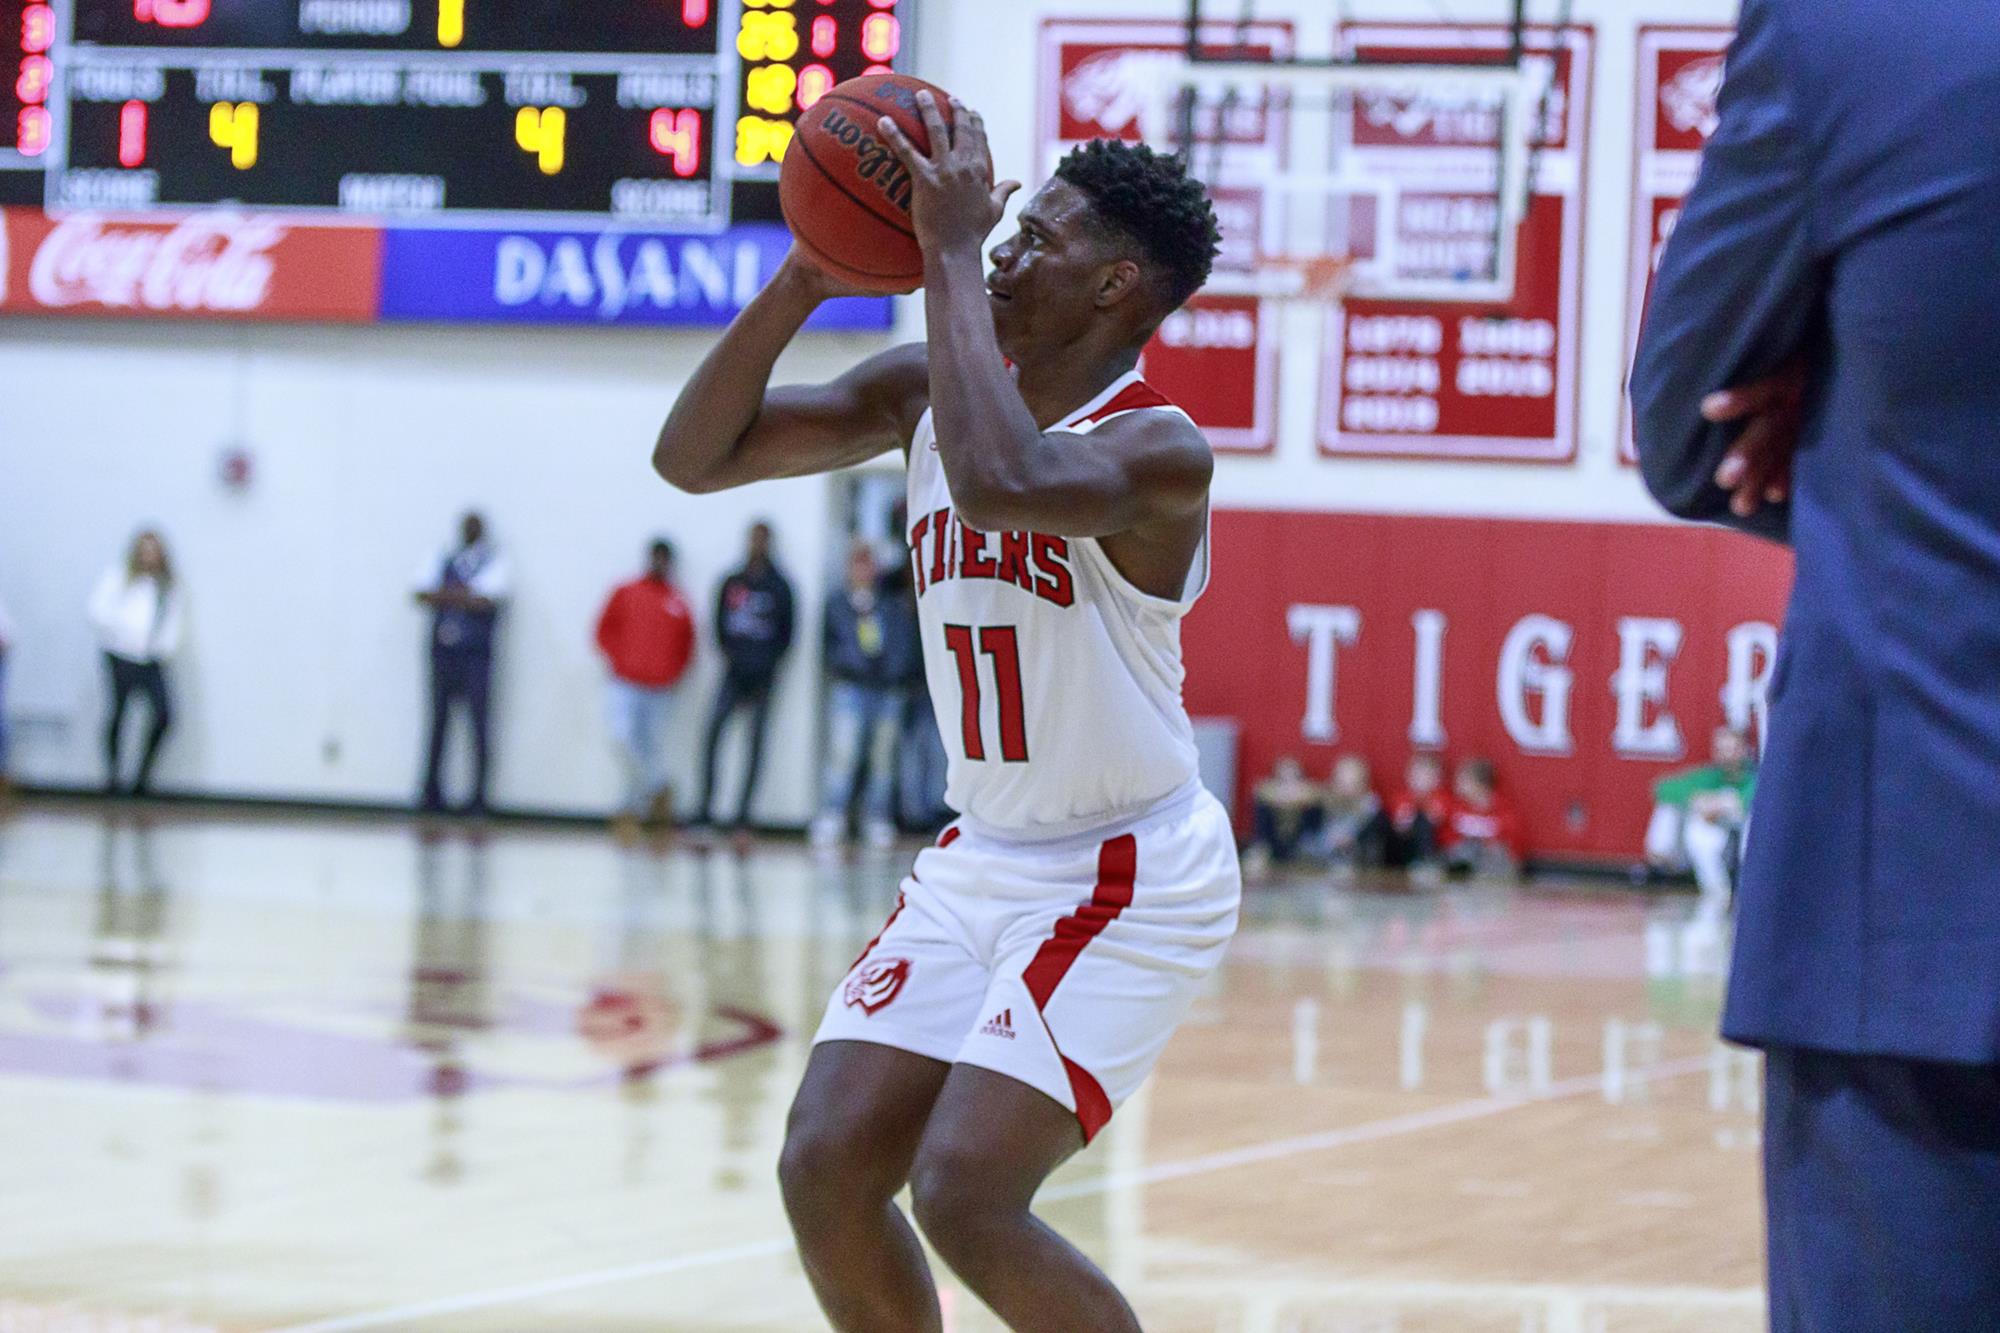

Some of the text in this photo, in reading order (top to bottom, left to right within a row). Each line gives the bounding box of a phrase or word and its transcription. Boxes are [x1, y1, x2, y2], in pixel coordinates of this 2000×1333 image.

[119, 99, 147, 168] 1
[209, 101, 259, 170] 4
[516, 106, 565, 175] 4
[650, 107, 700, 176] 4
[494, 230, 762, 318] DASANI
[911, 506, 1075, 609] TIERS
[943, 622, 1030, 763] 11
